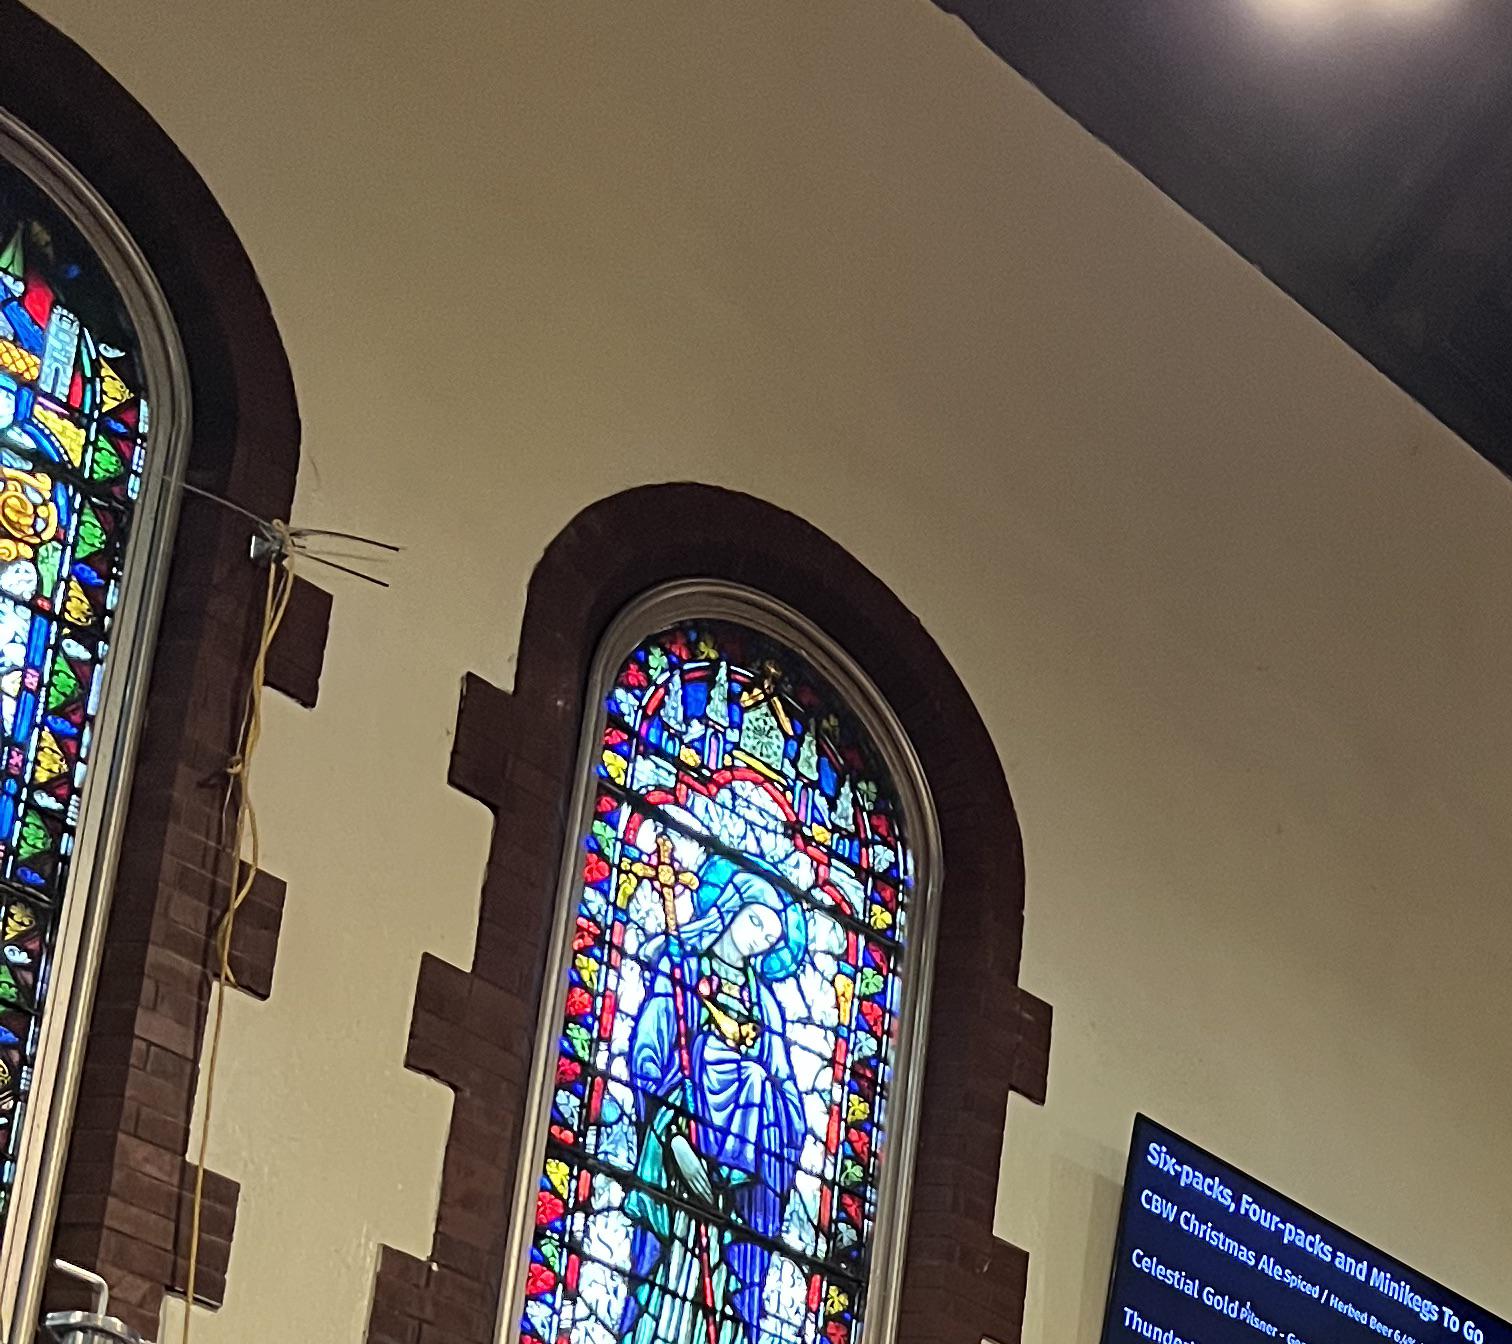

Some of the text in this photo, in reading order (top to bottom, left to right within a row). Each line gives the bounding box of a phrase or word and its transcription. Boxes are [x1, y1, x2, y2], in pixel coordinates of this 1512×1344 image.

[1132, 1248, 1200, 1299] Celestial
[1202, 1286, 1240, 1319] Gold
[1239, 1301, 1278, 1337] Pilsner
[1140, 1189, 1178, 1223] CBW
[1179, 1210, 1256, 1266] Christmas
[1257, 1254, 1283, 1281] Ale
[1283, 1268, 1320, 1299] Spiced
[1329, 1293, 1368, 1325] Herbed
[1369, 1315, 1393, 1338] Beer
[1146, 1142, 1236, 1213] Six-packs,
[1239, 1193, 1333, 1263] Four-packs
[1334, 1251, 1368, 1282] and
[1369, 1266, 1440, 1322] Minikegs
[1441, 1305, 1460, 1333] To
